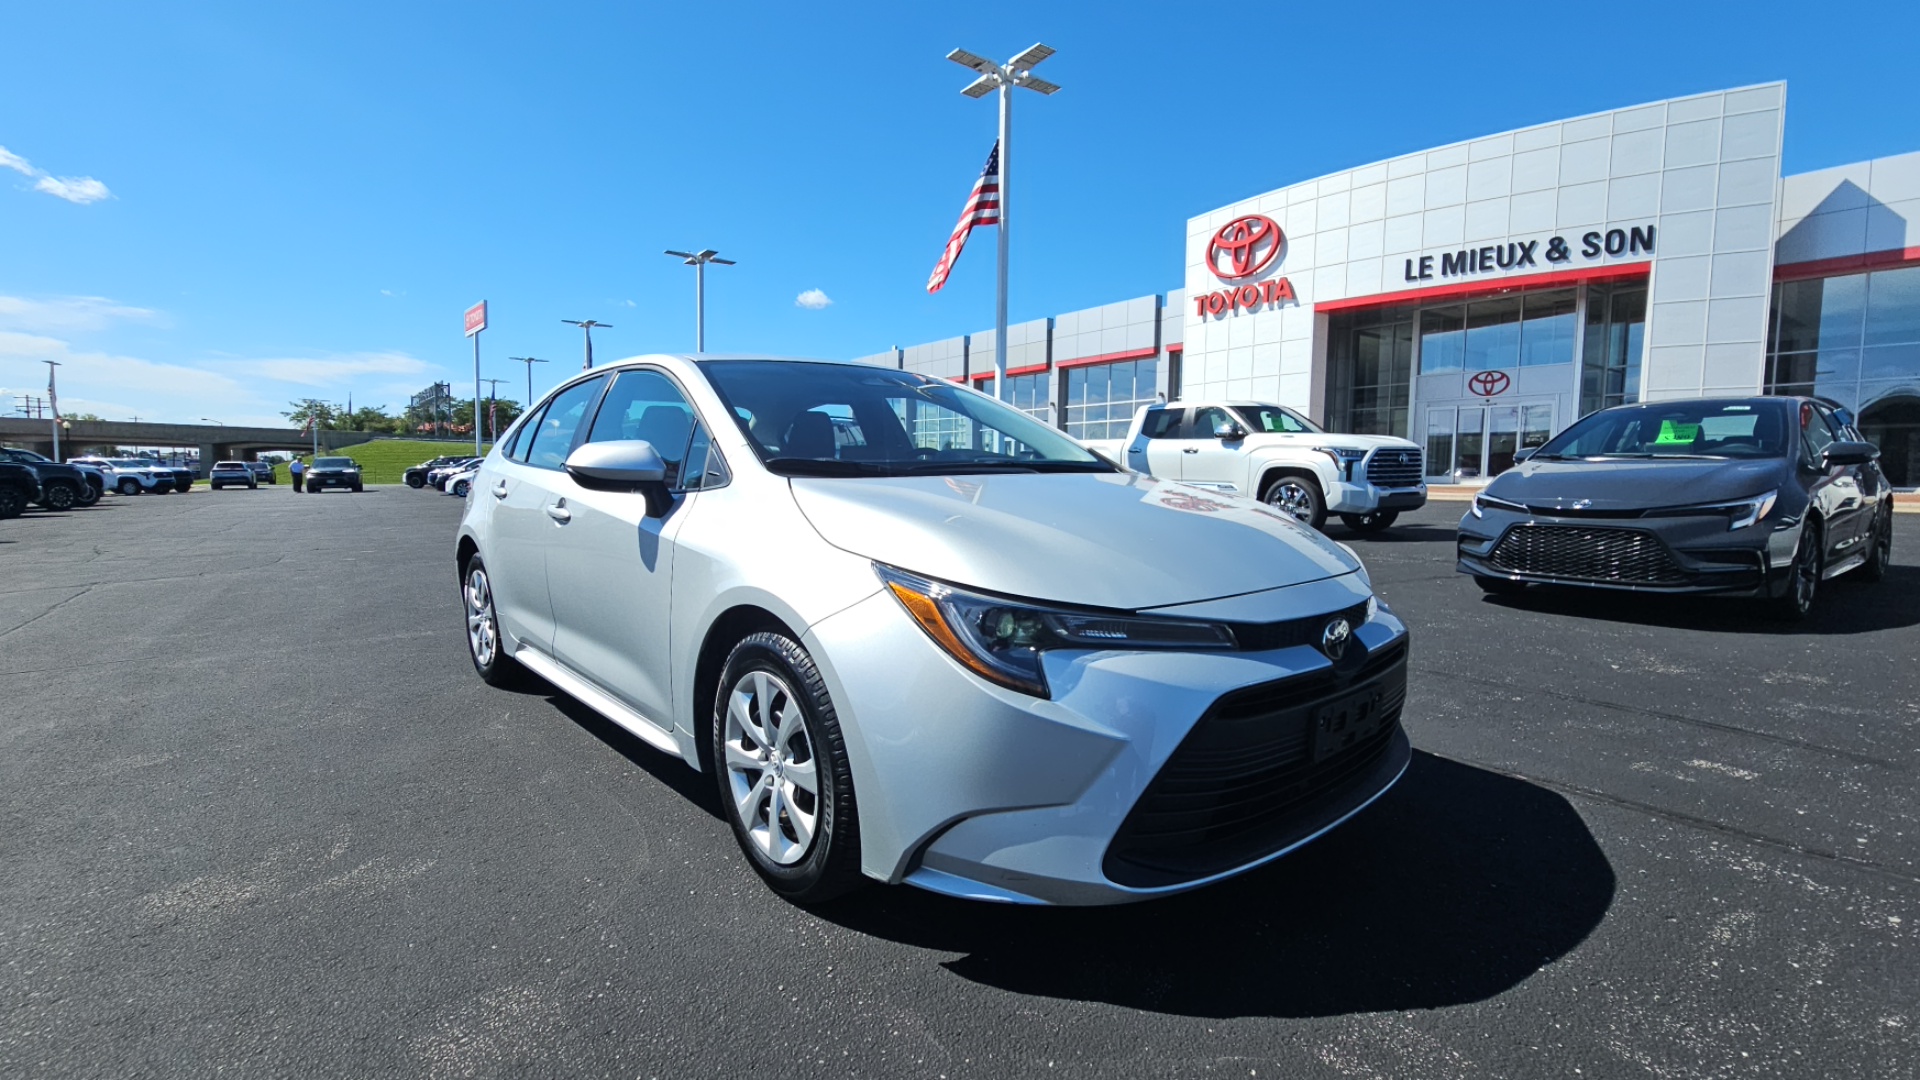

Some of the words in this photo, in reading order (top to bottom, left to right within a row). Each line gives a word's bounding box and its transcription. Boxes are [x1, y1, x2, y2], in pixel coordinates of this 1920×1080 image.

[1405, 255, 1433, 281] LE
[1441, 240, 1538, 276] MIEUX
[1545, 236, 1570, 261] &
[1581, 225, 1655, 257] SON
[1194, 277, 1295, 317] TOYOTA
